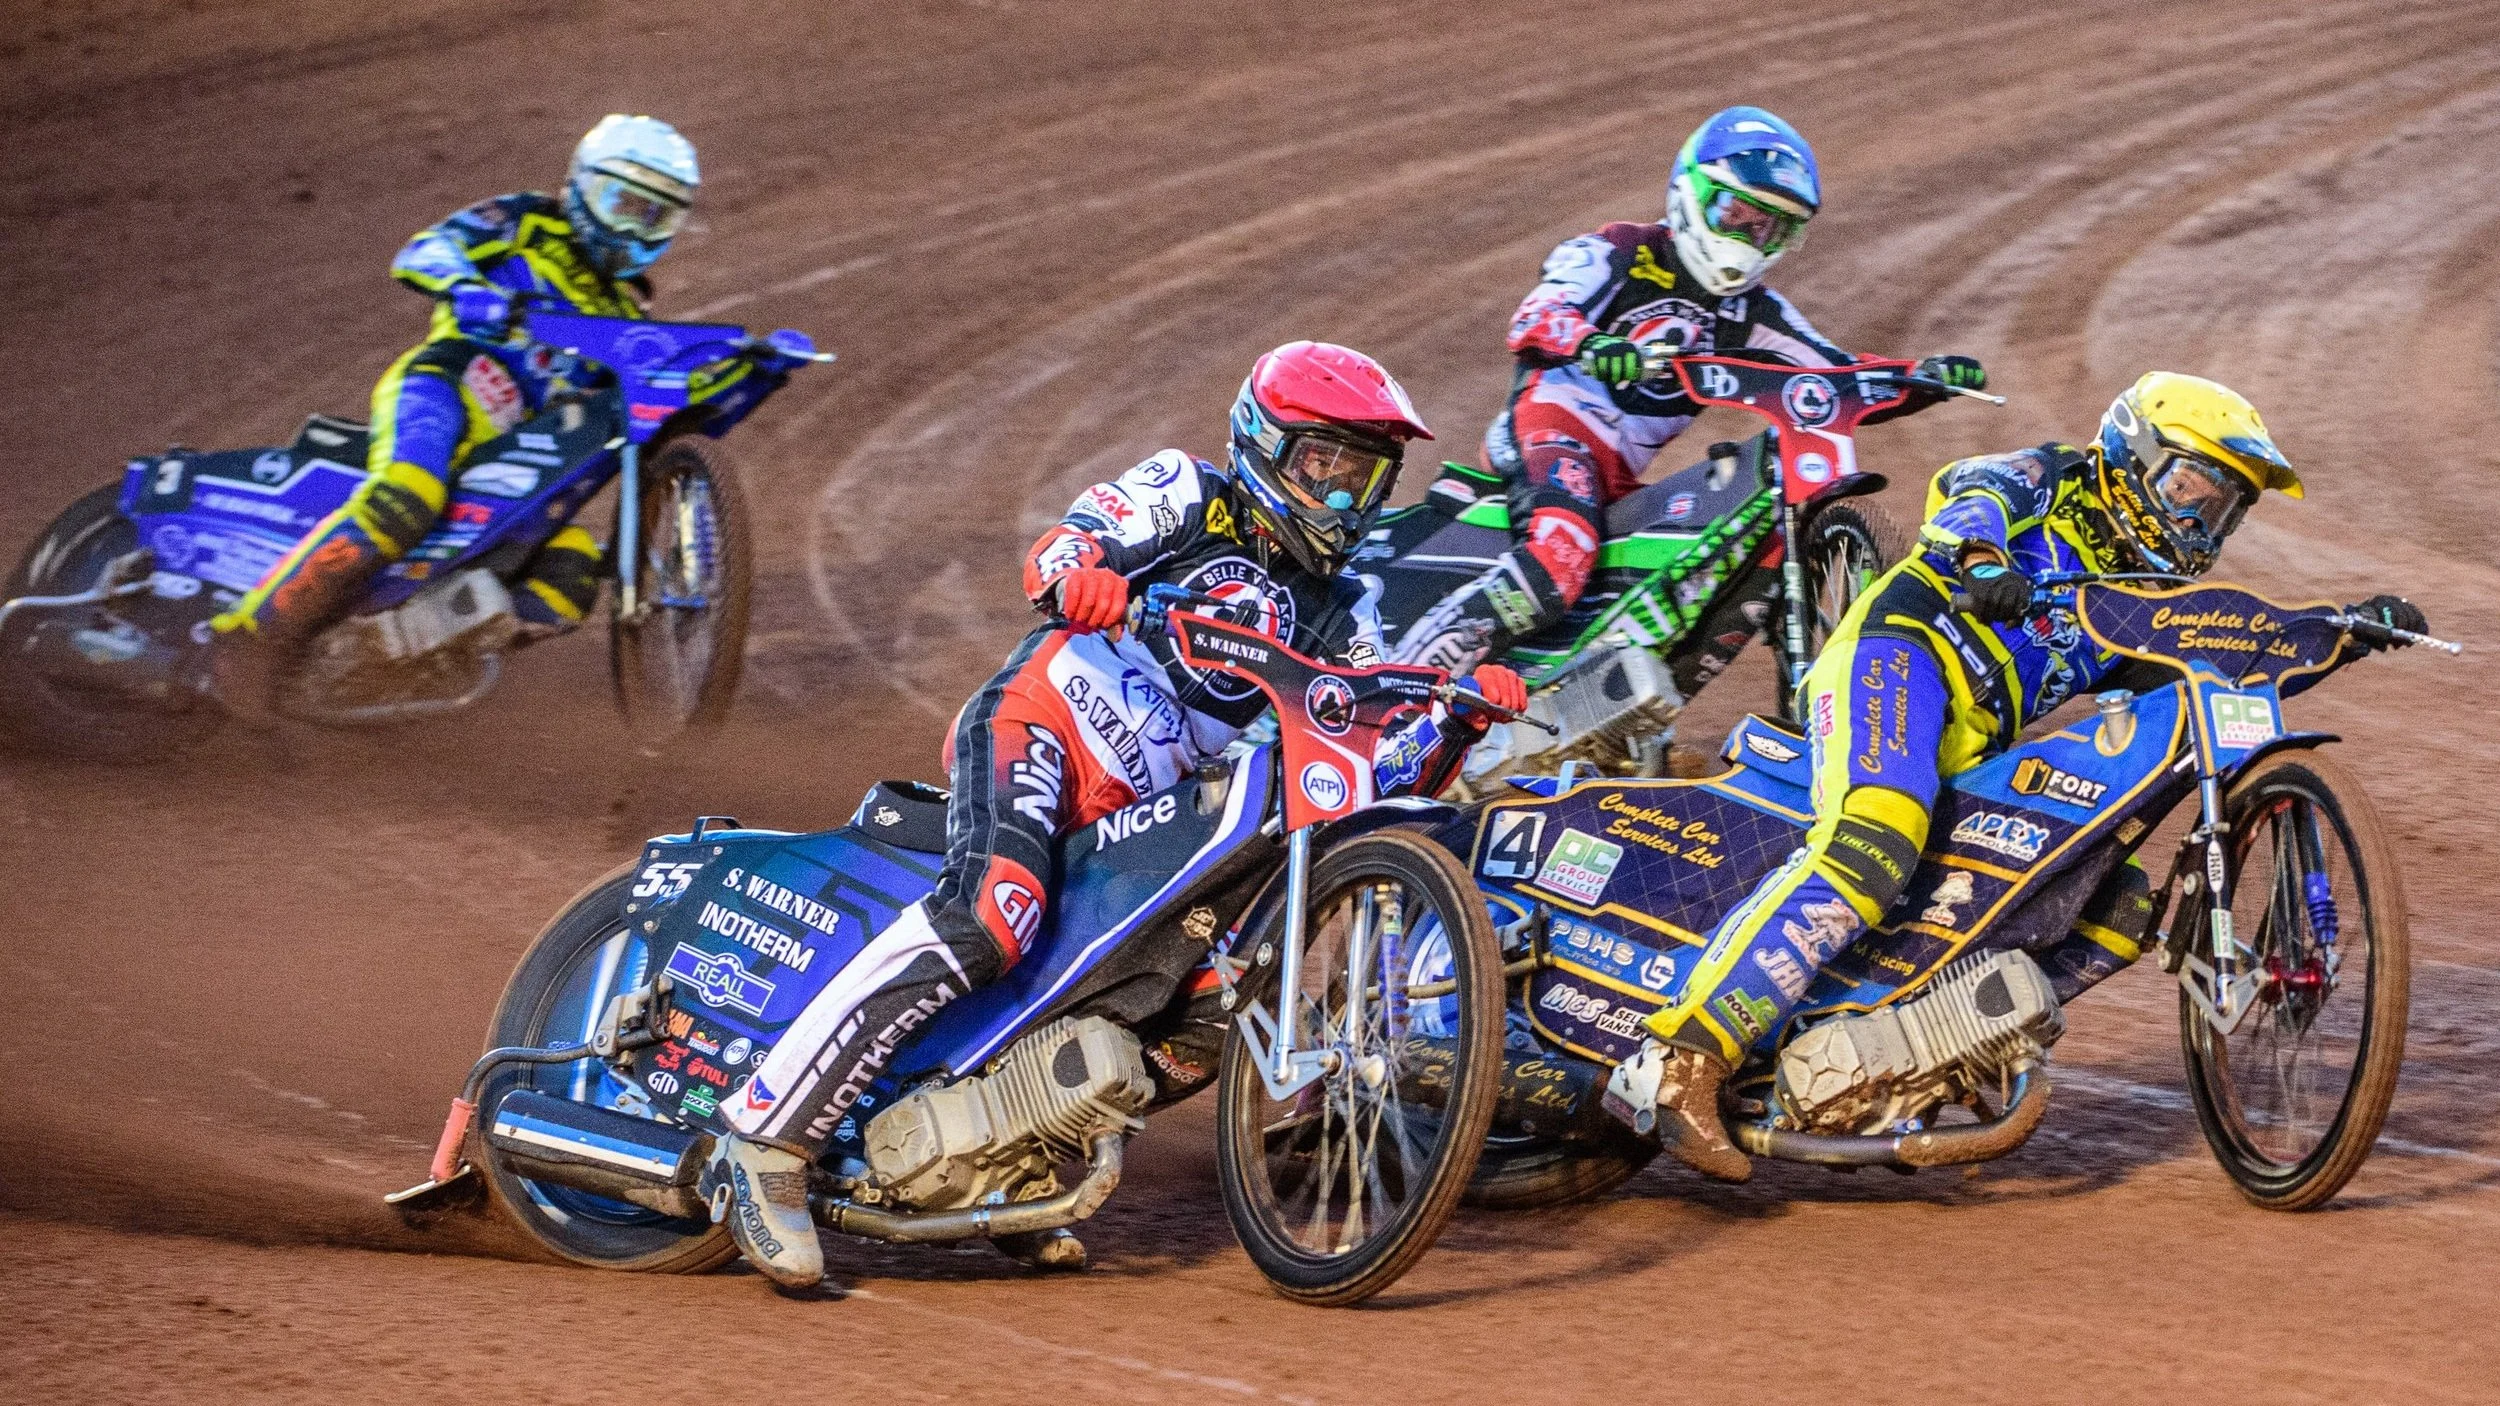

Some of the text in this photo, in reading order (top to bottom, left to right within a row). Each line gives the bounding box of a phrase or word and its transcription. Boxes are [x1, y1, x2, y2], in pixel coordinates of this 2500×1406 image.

[1202, 565, 1247, 588] BELLE
[2151, 606, 2244, 631] Complete
[1209, 636, 1269, 664] WARNER
[2177, 630, 2298, 659] Services Ltd
[1887, 648, 1910, 758] Services Ltd
[1858, 695, 1884, 775] Complete
[1309, 777, 1340, 796] ATPI
[2048, 769, 2108, 800] FORT
[1095, 793, 1177, 852] Nice
[1598, 792, 1721, 846] Complete Car
[1956, 812, 2050, 852] APEX
[1490, 815, 1536, 875] 4
[1549, 831, 1622, 876] PC
[1605, 818, 1725, 869] Services Ltd
[632, 862, 704, 899] 55
[1542, 869, 1600, 896] SERVICES
[1556, 861, 1606, 885] GROUP
[722, 867, 841, 936] S. WARNER
[992, 879, 1042, 956] GM
[698, 901, 816, 973] INOTHERM
[1549, 918, 1636, 966] PBHS
[691, 960, 746, 1000] REALL
[1598, 1016, 1632, 1035] VANS
[1724, 993, 1756, 1027] ROCK
[805, 982, 957, 1141] INOTHERM
[1515, 1060, 1567, 1082] Car
